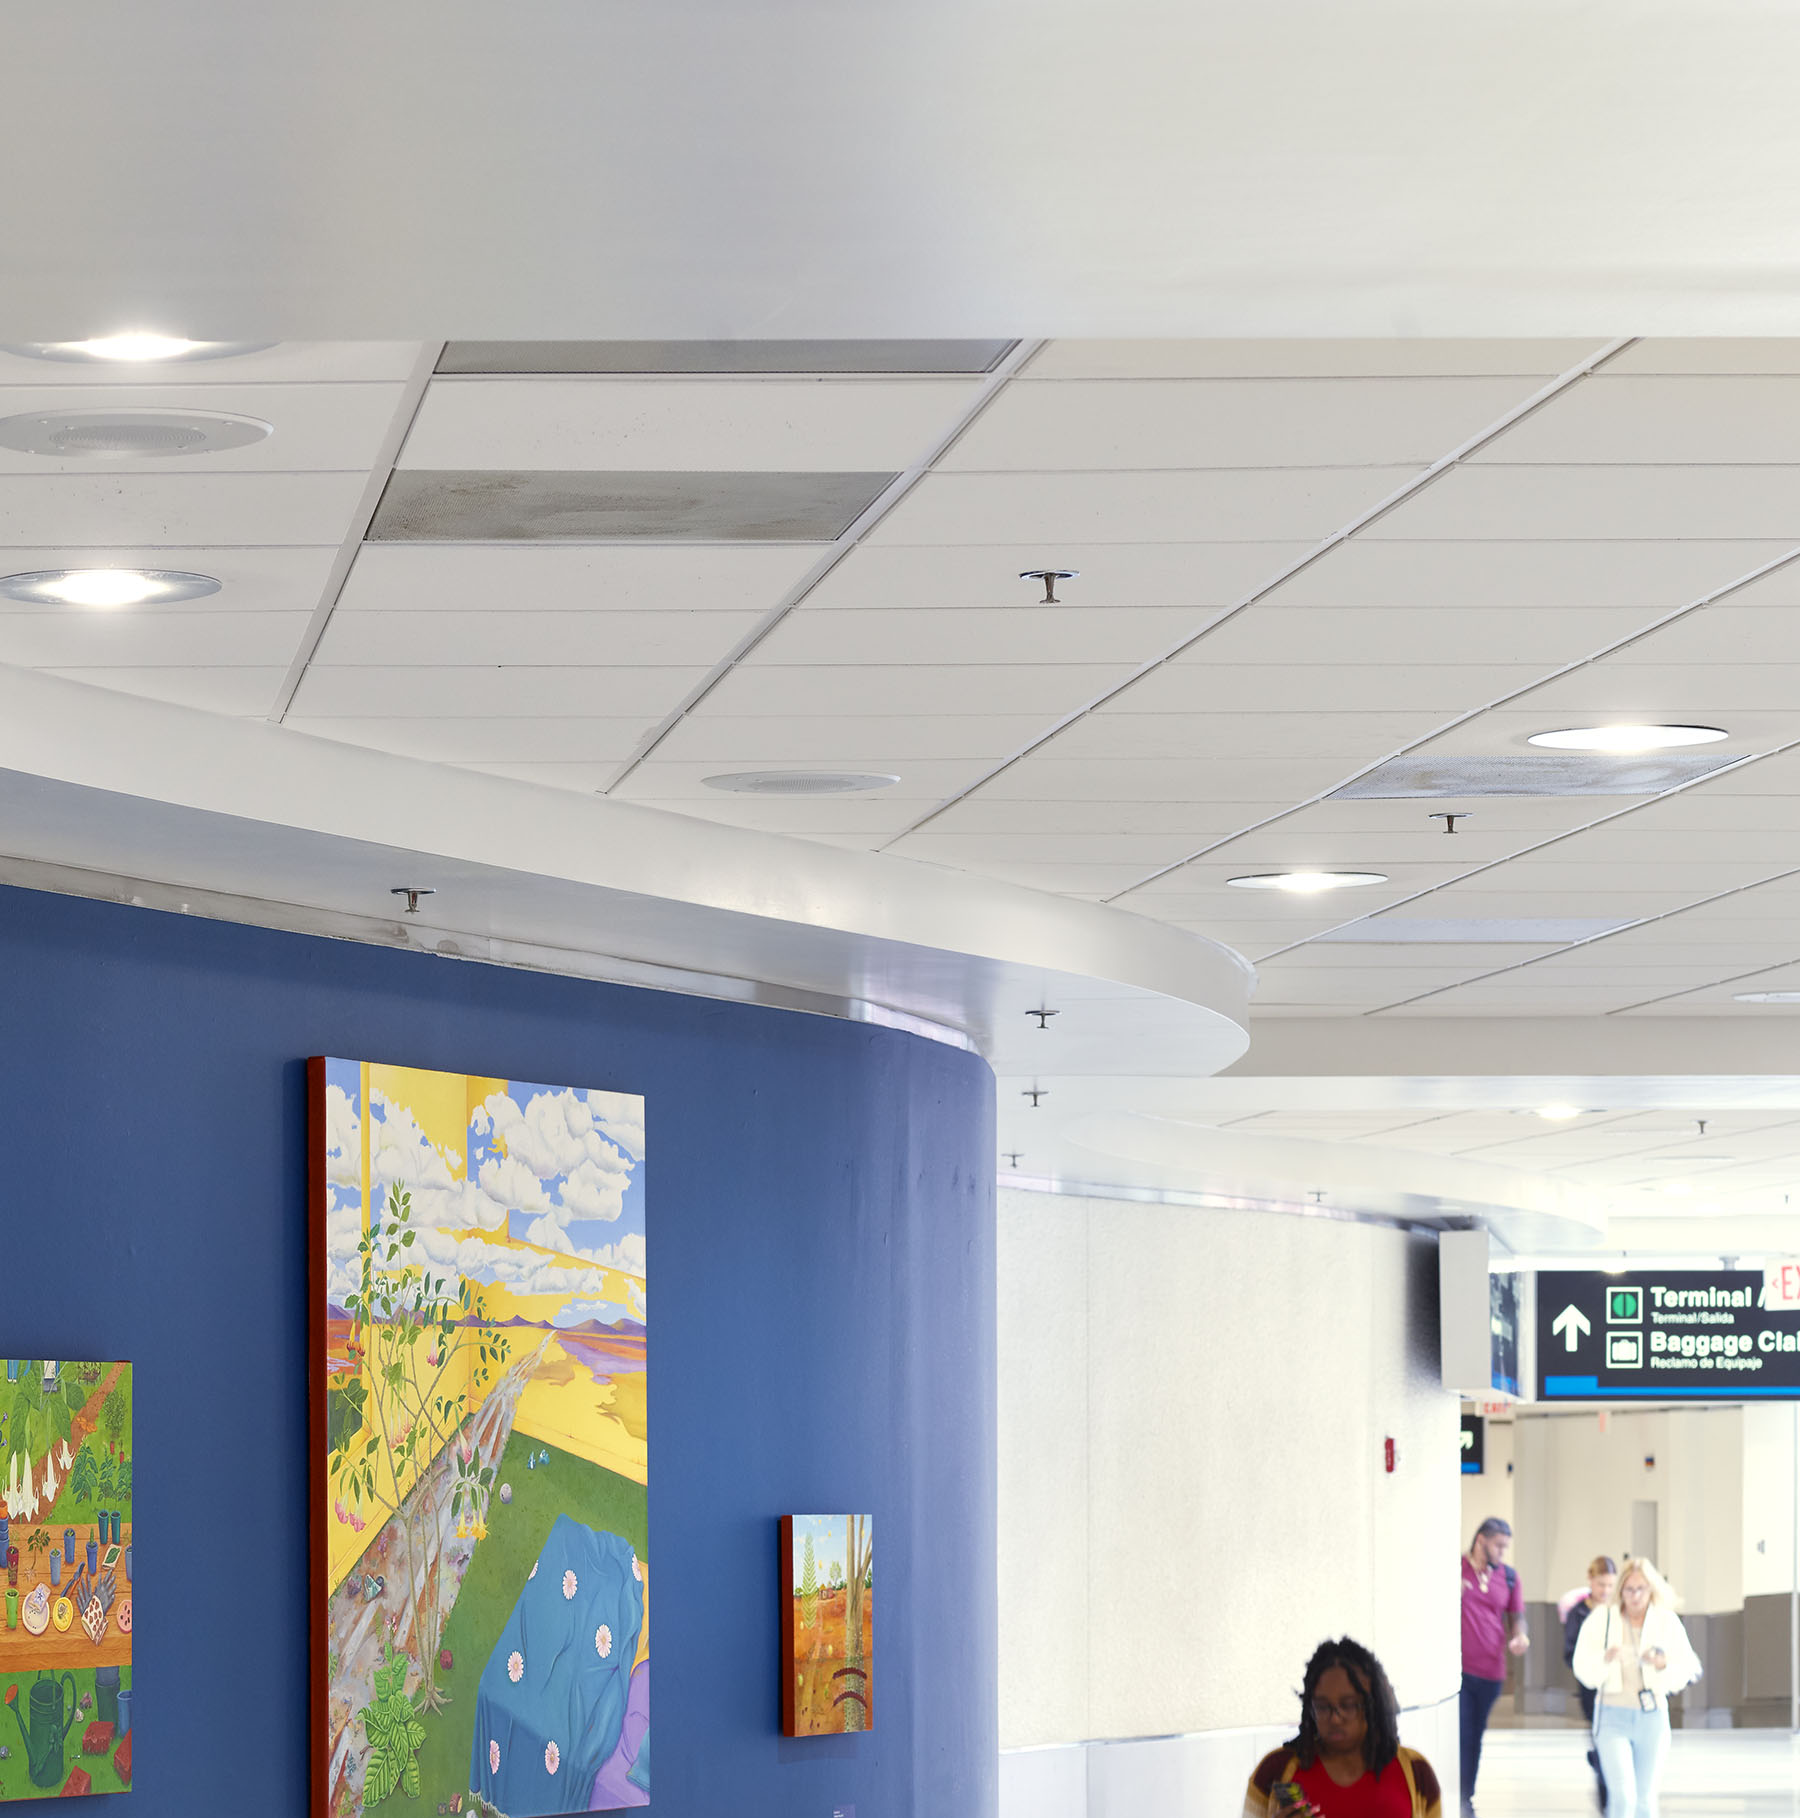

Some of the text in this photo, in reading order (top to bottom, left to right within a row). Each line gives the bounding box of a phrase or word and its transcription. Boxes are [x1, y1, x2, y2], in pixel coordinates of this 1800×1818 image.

[1650, 1286, 1752, 1308] Terminal
[1651, 1311, 1735, 1324] Terminal/Salida
[1650, 1331, 1753, 1357] Baggage
[1650, 1356, 1763, 1371] Reclamo de Equipaje
